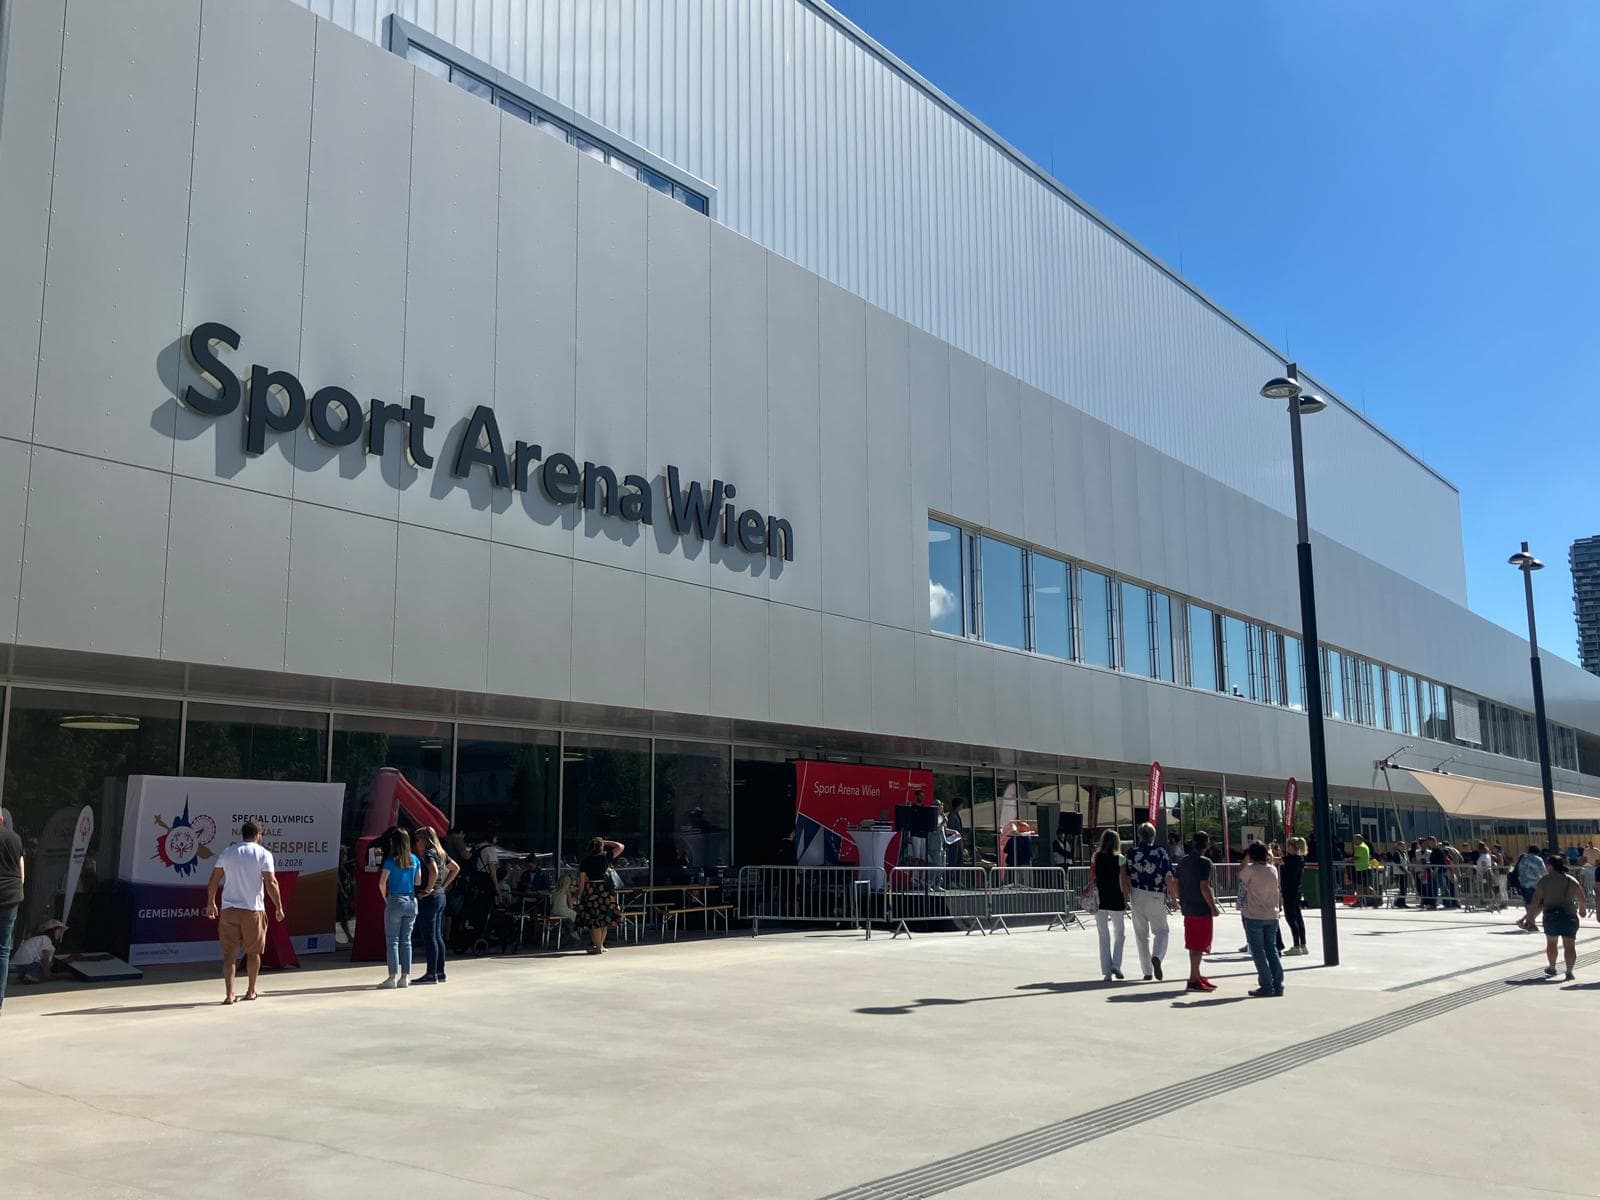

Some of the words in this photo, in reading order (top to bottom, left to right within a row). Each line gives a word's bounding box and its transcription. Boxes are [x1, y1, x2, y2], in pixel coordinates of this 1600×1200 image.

[185, 322, 435, 470] Sport
[455, 404, 653, 526] Arena
[667, 464, 794, 562] Wien
[814, 781, 836, 796] Sport
[838, 783, 860, 796] Arena
[861, 784, 881, 797] Wien
[232, 814, 269, 824] SPECIAL
[271, 815, 314, 824] OLYMPICS
[138, 907, 199, 919] GEMEINSAM
